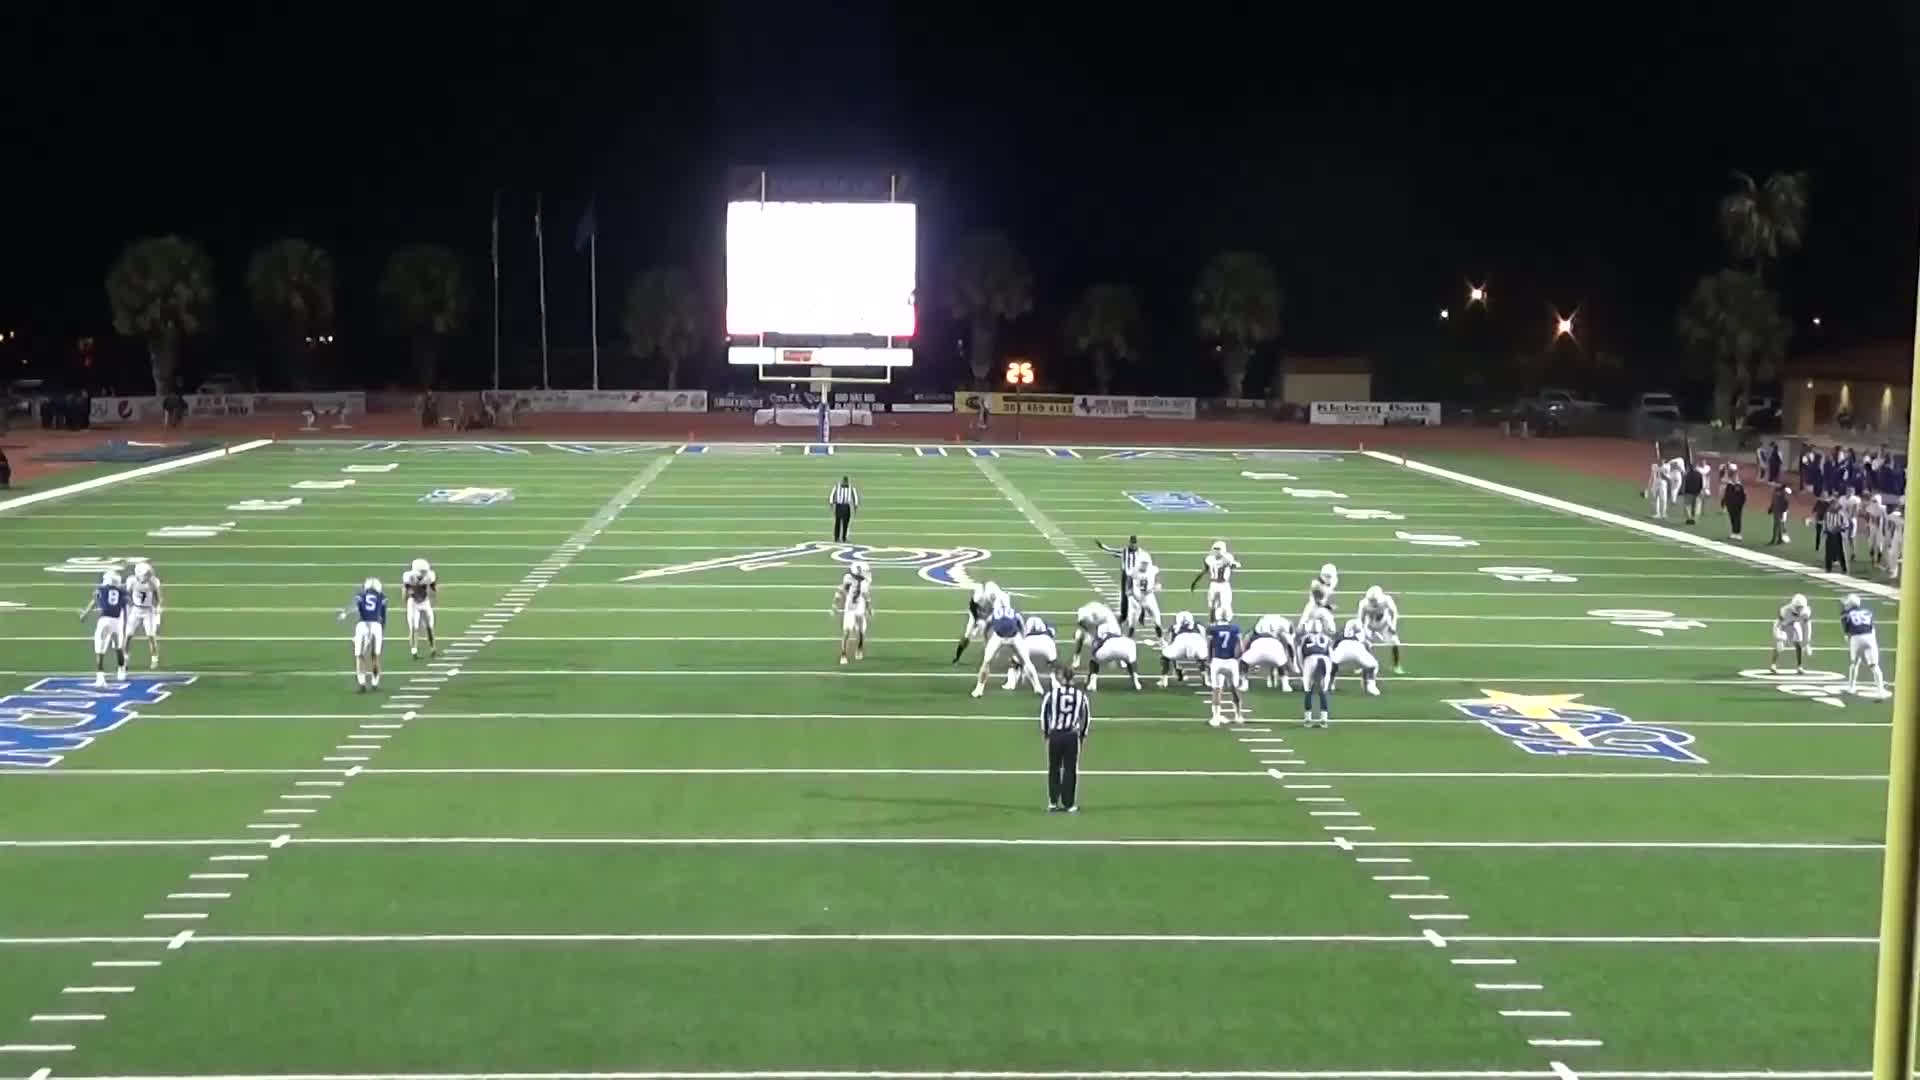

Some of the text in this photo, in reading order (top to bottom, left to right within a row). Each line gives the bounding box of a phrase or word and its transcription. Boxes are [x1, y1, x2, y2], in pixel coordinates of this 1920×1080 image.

[1005, 362, 1035, 383] 25
[108, 590, 120, 606] 8
[365, 594, 378, 611] 5
[1218, 631, 1231, 648] 7
[1060, 694, 1074, 713] C
